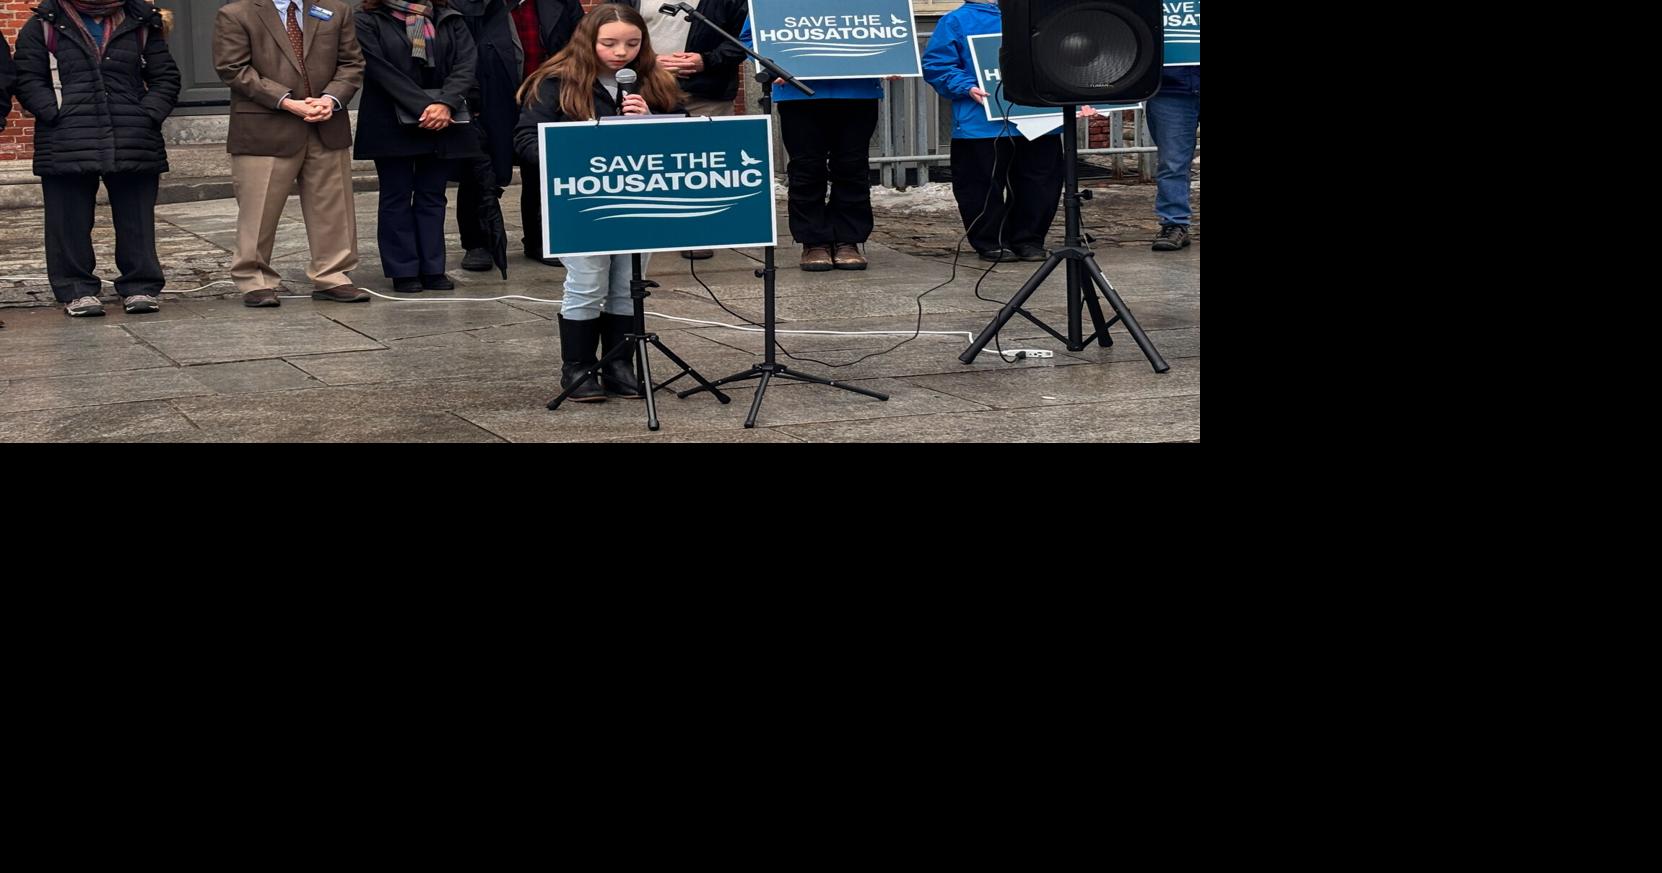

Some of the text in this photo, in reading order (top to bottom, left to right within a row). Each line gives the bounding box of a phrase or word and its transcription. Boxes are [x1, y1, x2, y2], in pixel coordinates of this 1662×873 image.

[1163, 2, 1195, 13] AVE
[784, 14, 882, 28] SAVE THE
[759, 26, 908, 42] HOUSATONIC
[590, 151, 727, 174] SAVE THE
[554, 168, 763, 196] HOUSATONIC
